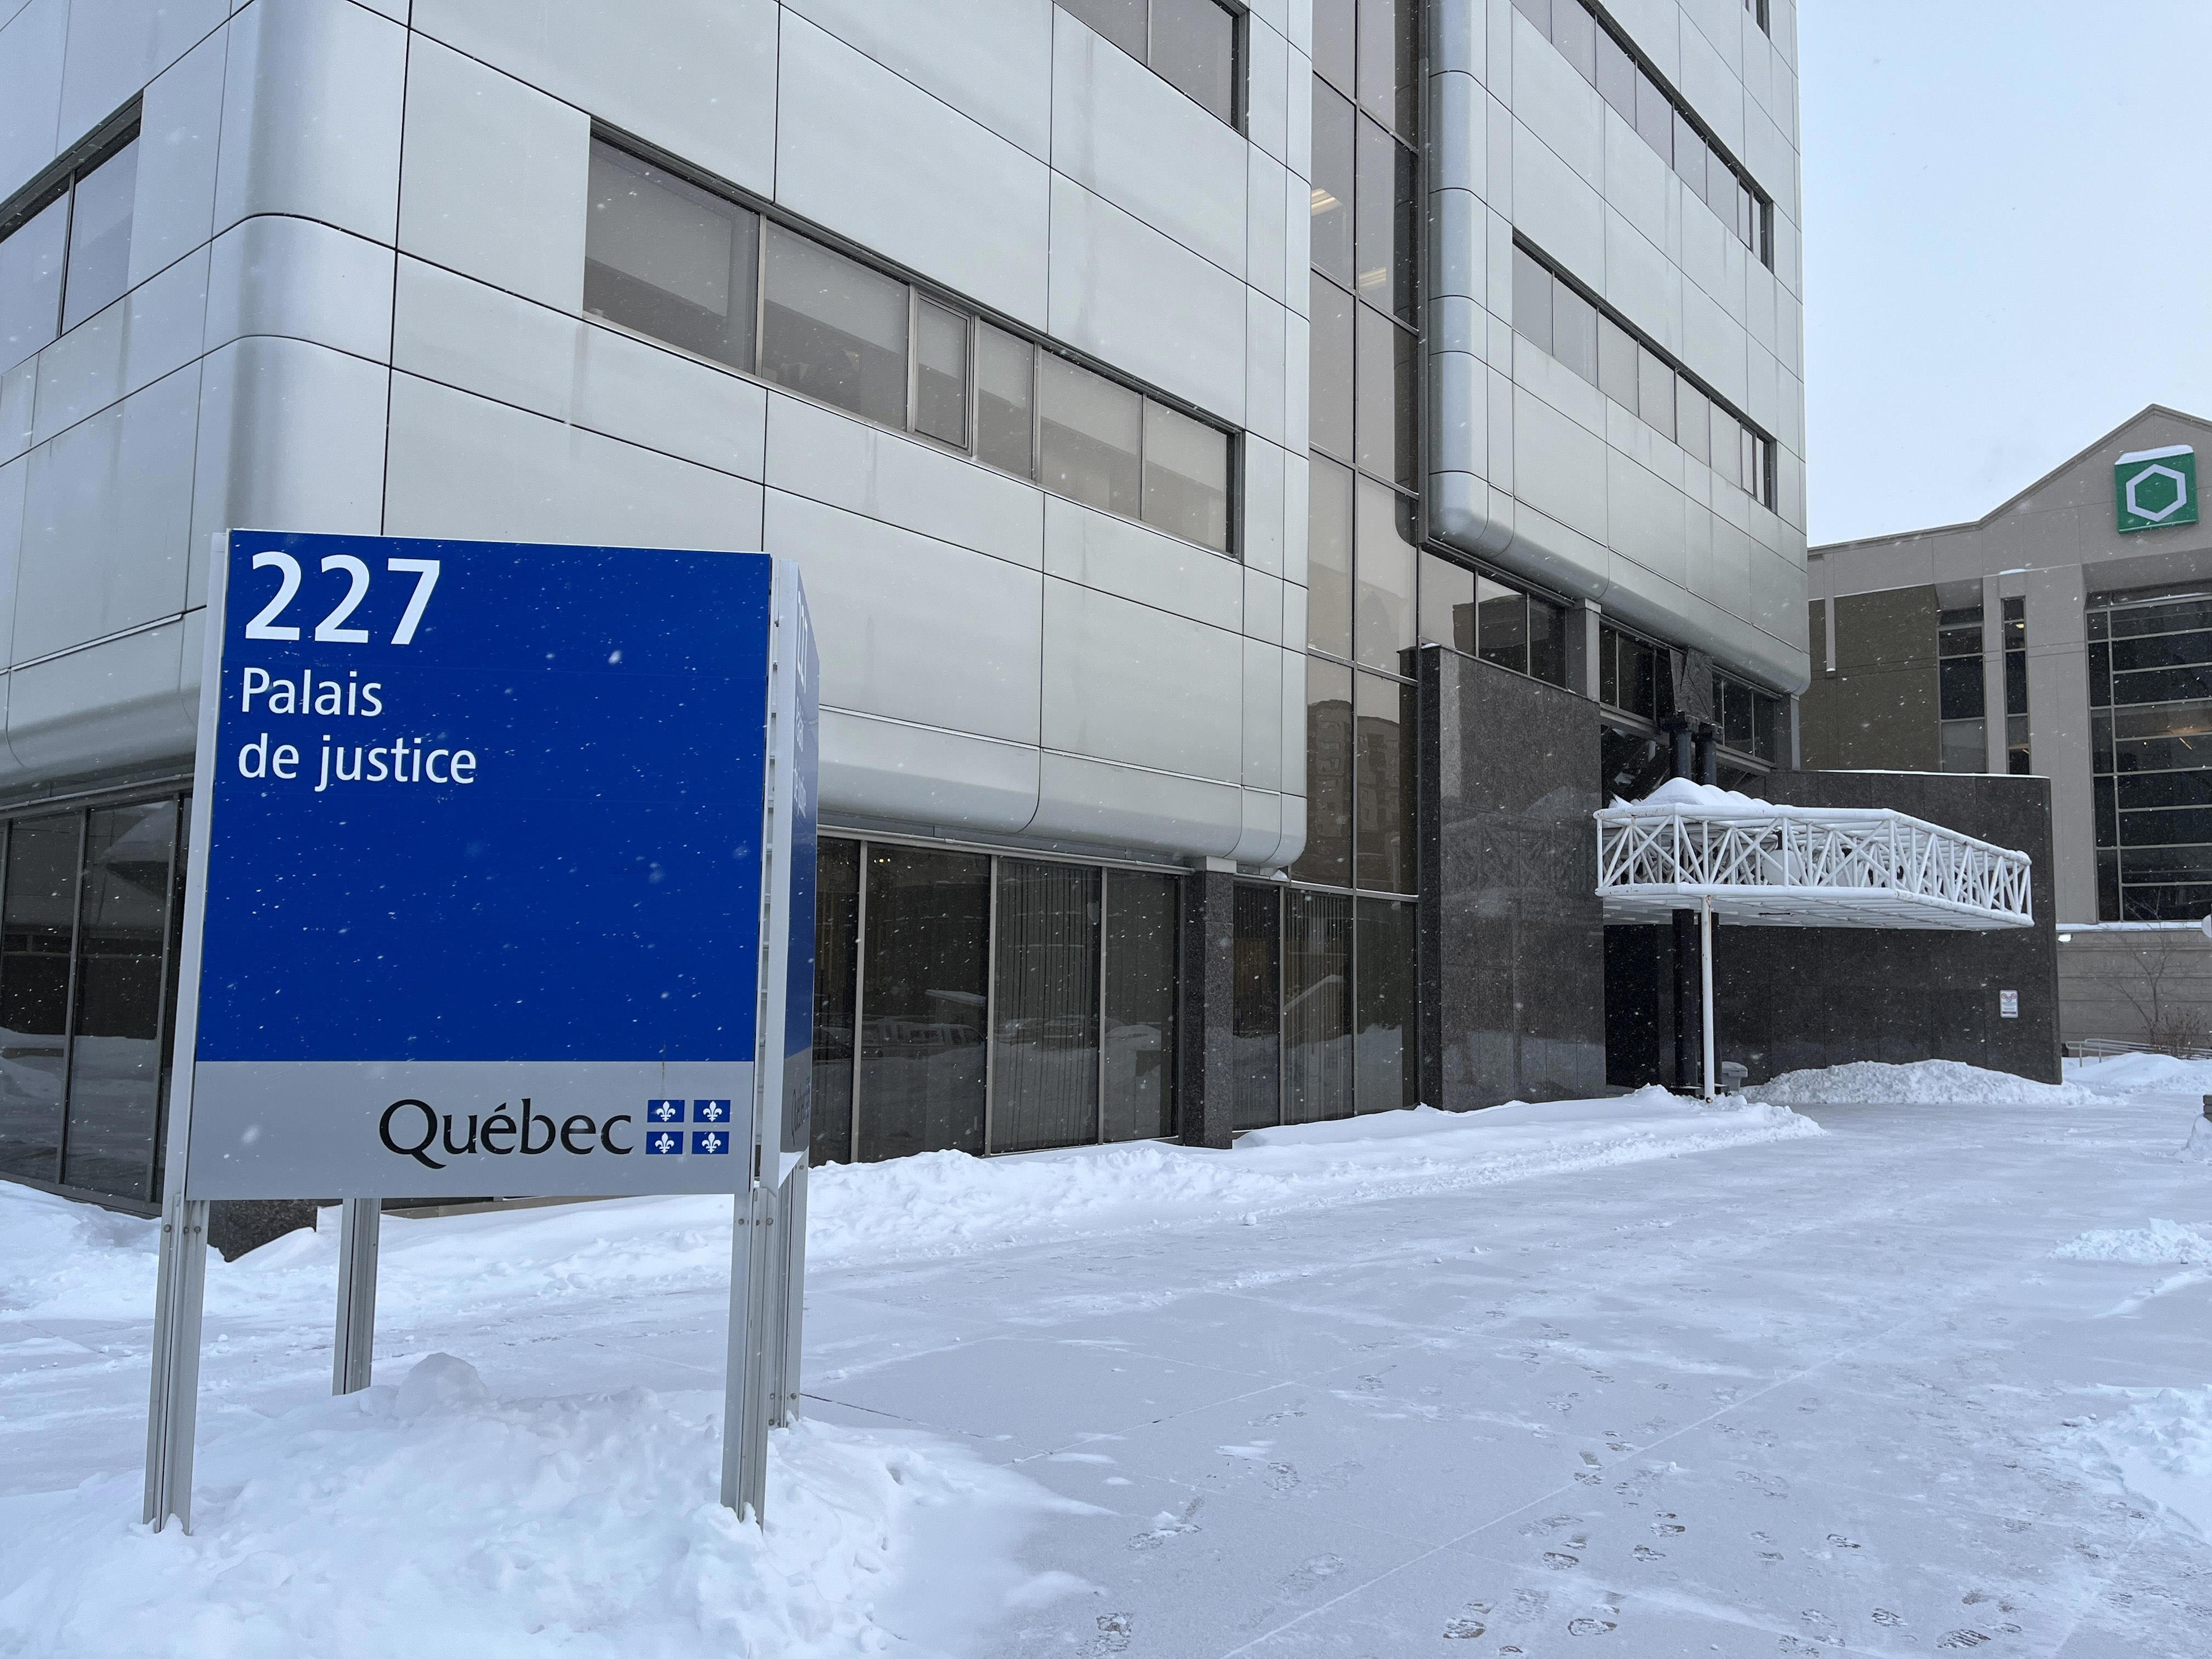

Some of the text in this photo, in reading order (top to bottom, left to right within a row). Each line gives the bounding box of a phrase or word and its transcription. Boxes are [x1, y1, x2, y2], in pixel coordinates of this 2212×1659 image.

[245, 552, 440, 644] 227
[242, 668, 382, 716] Palais
[239, 733, 476, 792] de justice
[379, 1098, 634, 1169] Québec
